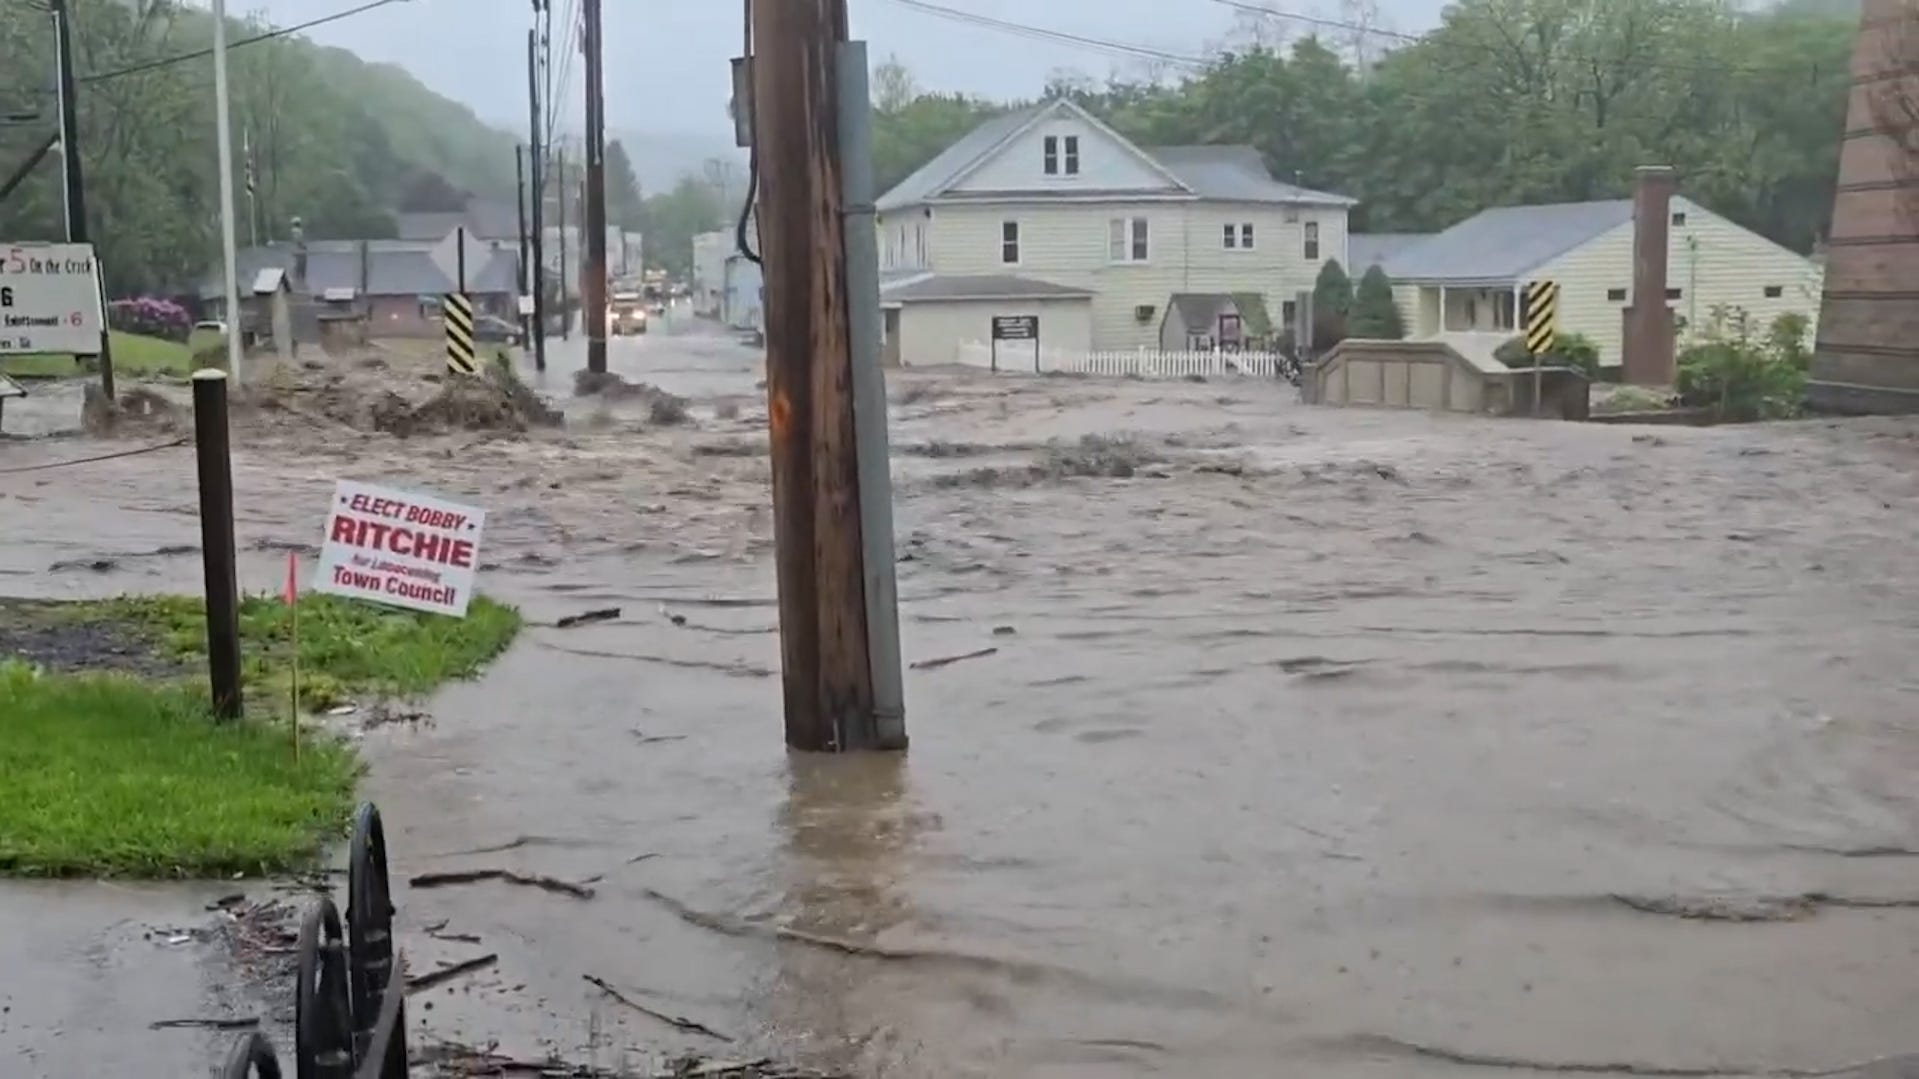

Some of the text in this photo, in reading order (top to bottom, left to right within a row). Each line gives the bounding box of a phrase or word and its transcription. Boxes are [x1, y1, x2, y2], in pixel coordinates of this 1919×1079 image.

[10, 248, 26, 274] 5
[350, 493, 467, 531] ELECT BOBBY
[331, 515, 474, 567] RITCHIE
[333, 566, 457, 606] Town Council
